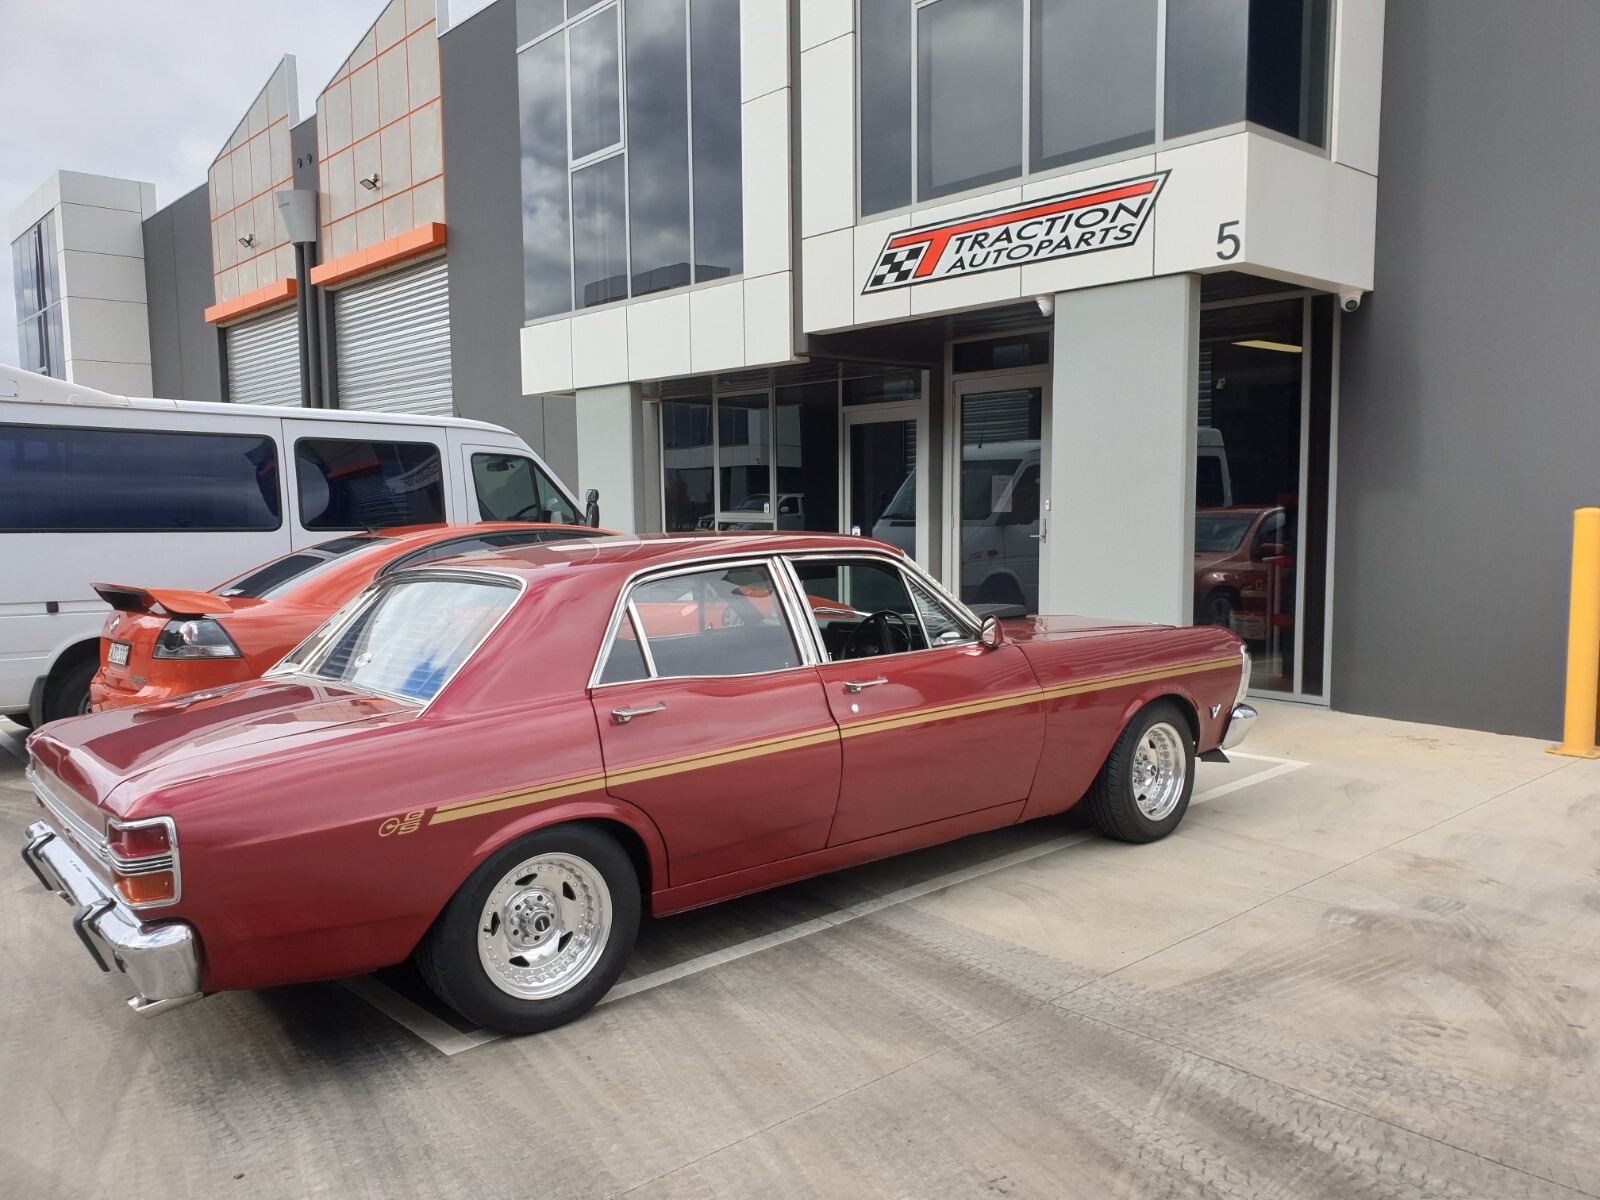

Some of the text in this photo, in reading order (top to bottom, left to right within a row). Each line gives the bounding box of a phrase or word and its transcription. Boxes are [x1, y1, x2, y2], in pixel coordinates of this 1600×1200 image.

[945, 222, 1137, 274] AUTOPARTS
[955, 197, 1149, 254] TRACTION
[1216, 219, 1241, 260] 5
